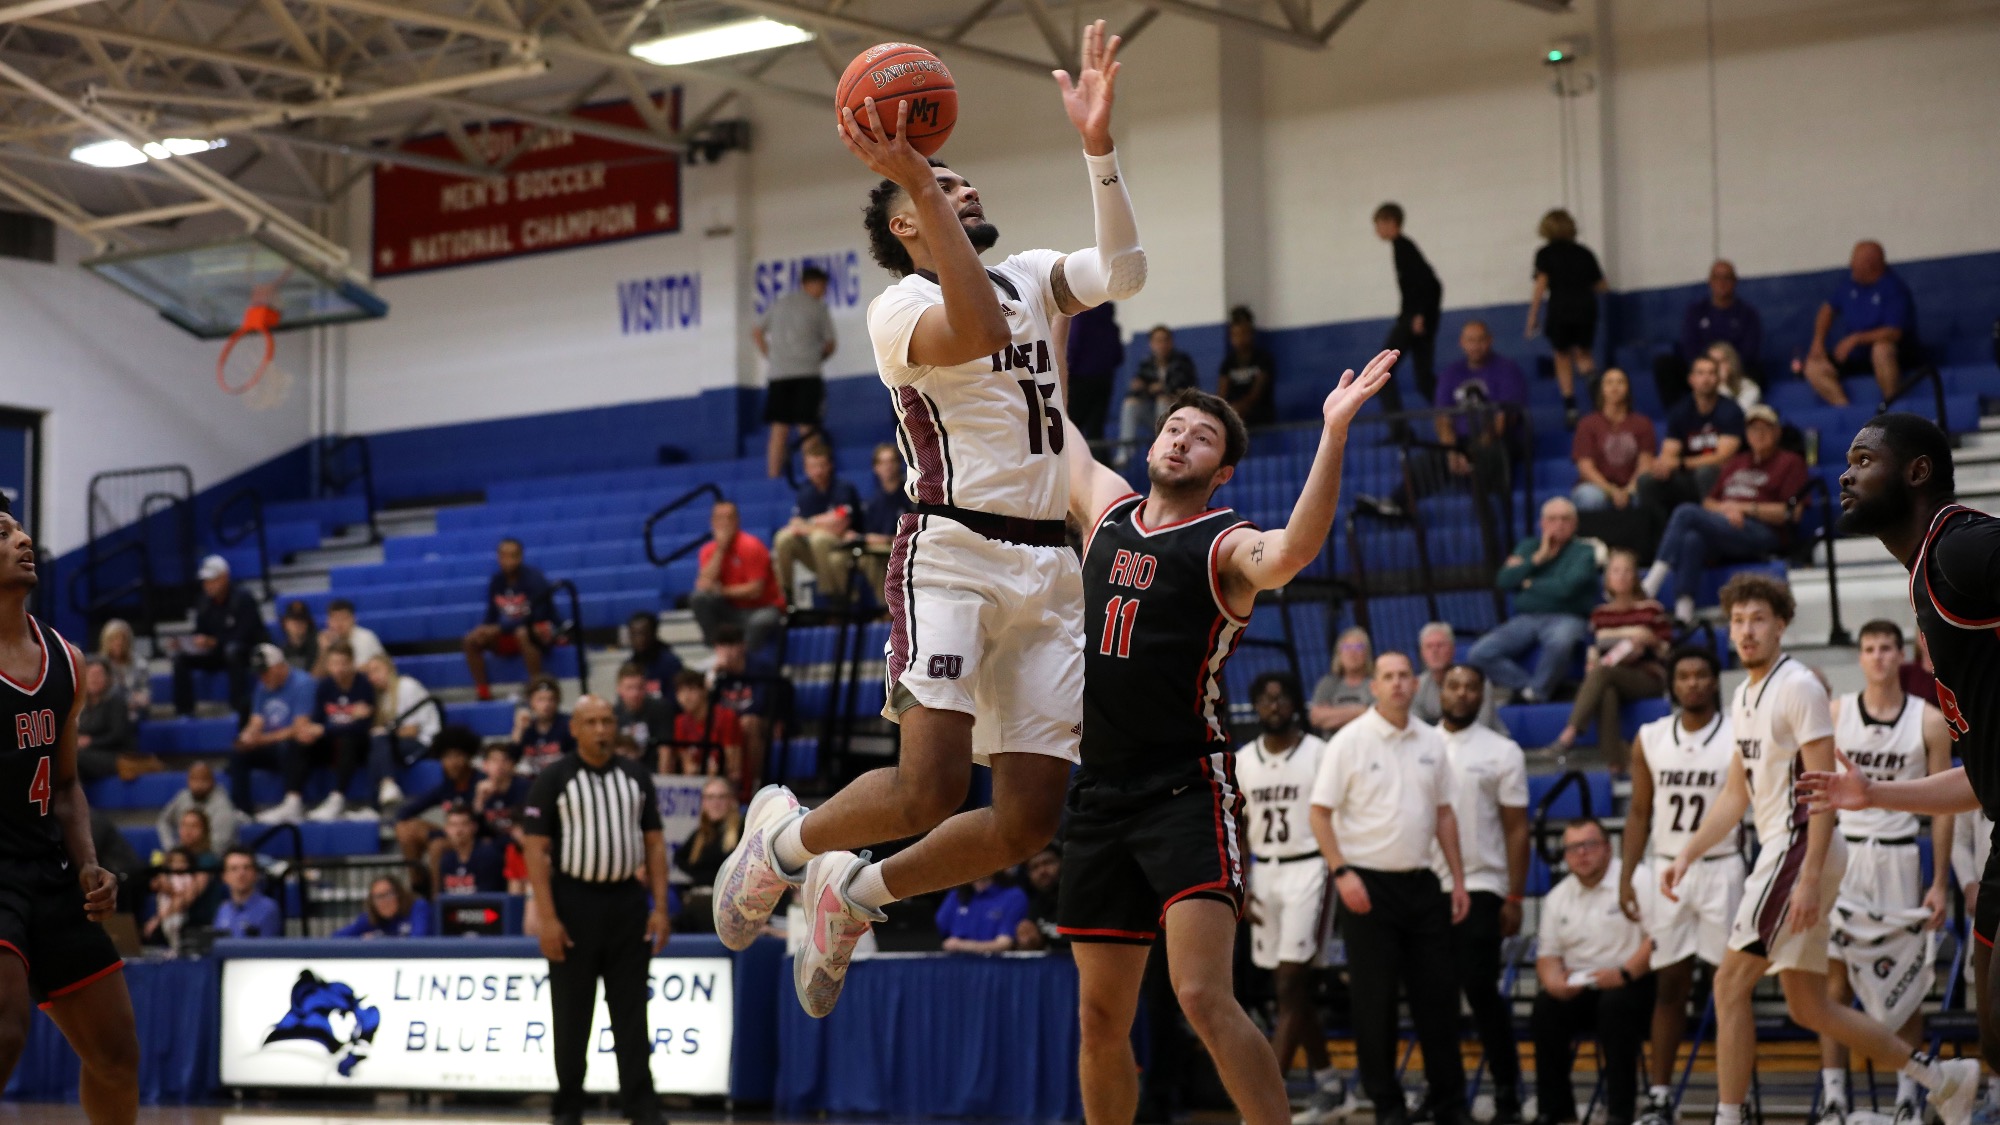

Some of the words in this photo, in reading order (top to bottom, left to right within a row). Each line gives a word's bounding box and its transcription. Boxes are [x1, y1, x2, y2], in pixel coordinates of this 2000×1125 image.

[441, 178, 508, 212] MEN'S
[515, 164, 606, 199] SOCCER
[410, 224, 514, 265] NATIONAL
[521, 203, 637, 246] CHAMPION
[1018, 380, 1064, 455] 15
[1109, 549, 1157, 590] RIO
[1100, 595, 1140, 658] 11
[927, 653, 963, 680] CU
[15, 708, 56, 750] RIO
[28, 756, 51, 817] 4
[1251, 785, 1299, 803] TIGERS
[1659, 769, 1717, 787] TIGERS
[1263, 807, 1290, 843] 23
[1669, 794, 1705, 832] 22
[393, 969, 551, 1001] LINDSEY
[646, 973, 715, 1002] SON
[405, 1021, 502, 1052] BLUE
[522, 1021, 701, 1055] RDRS
